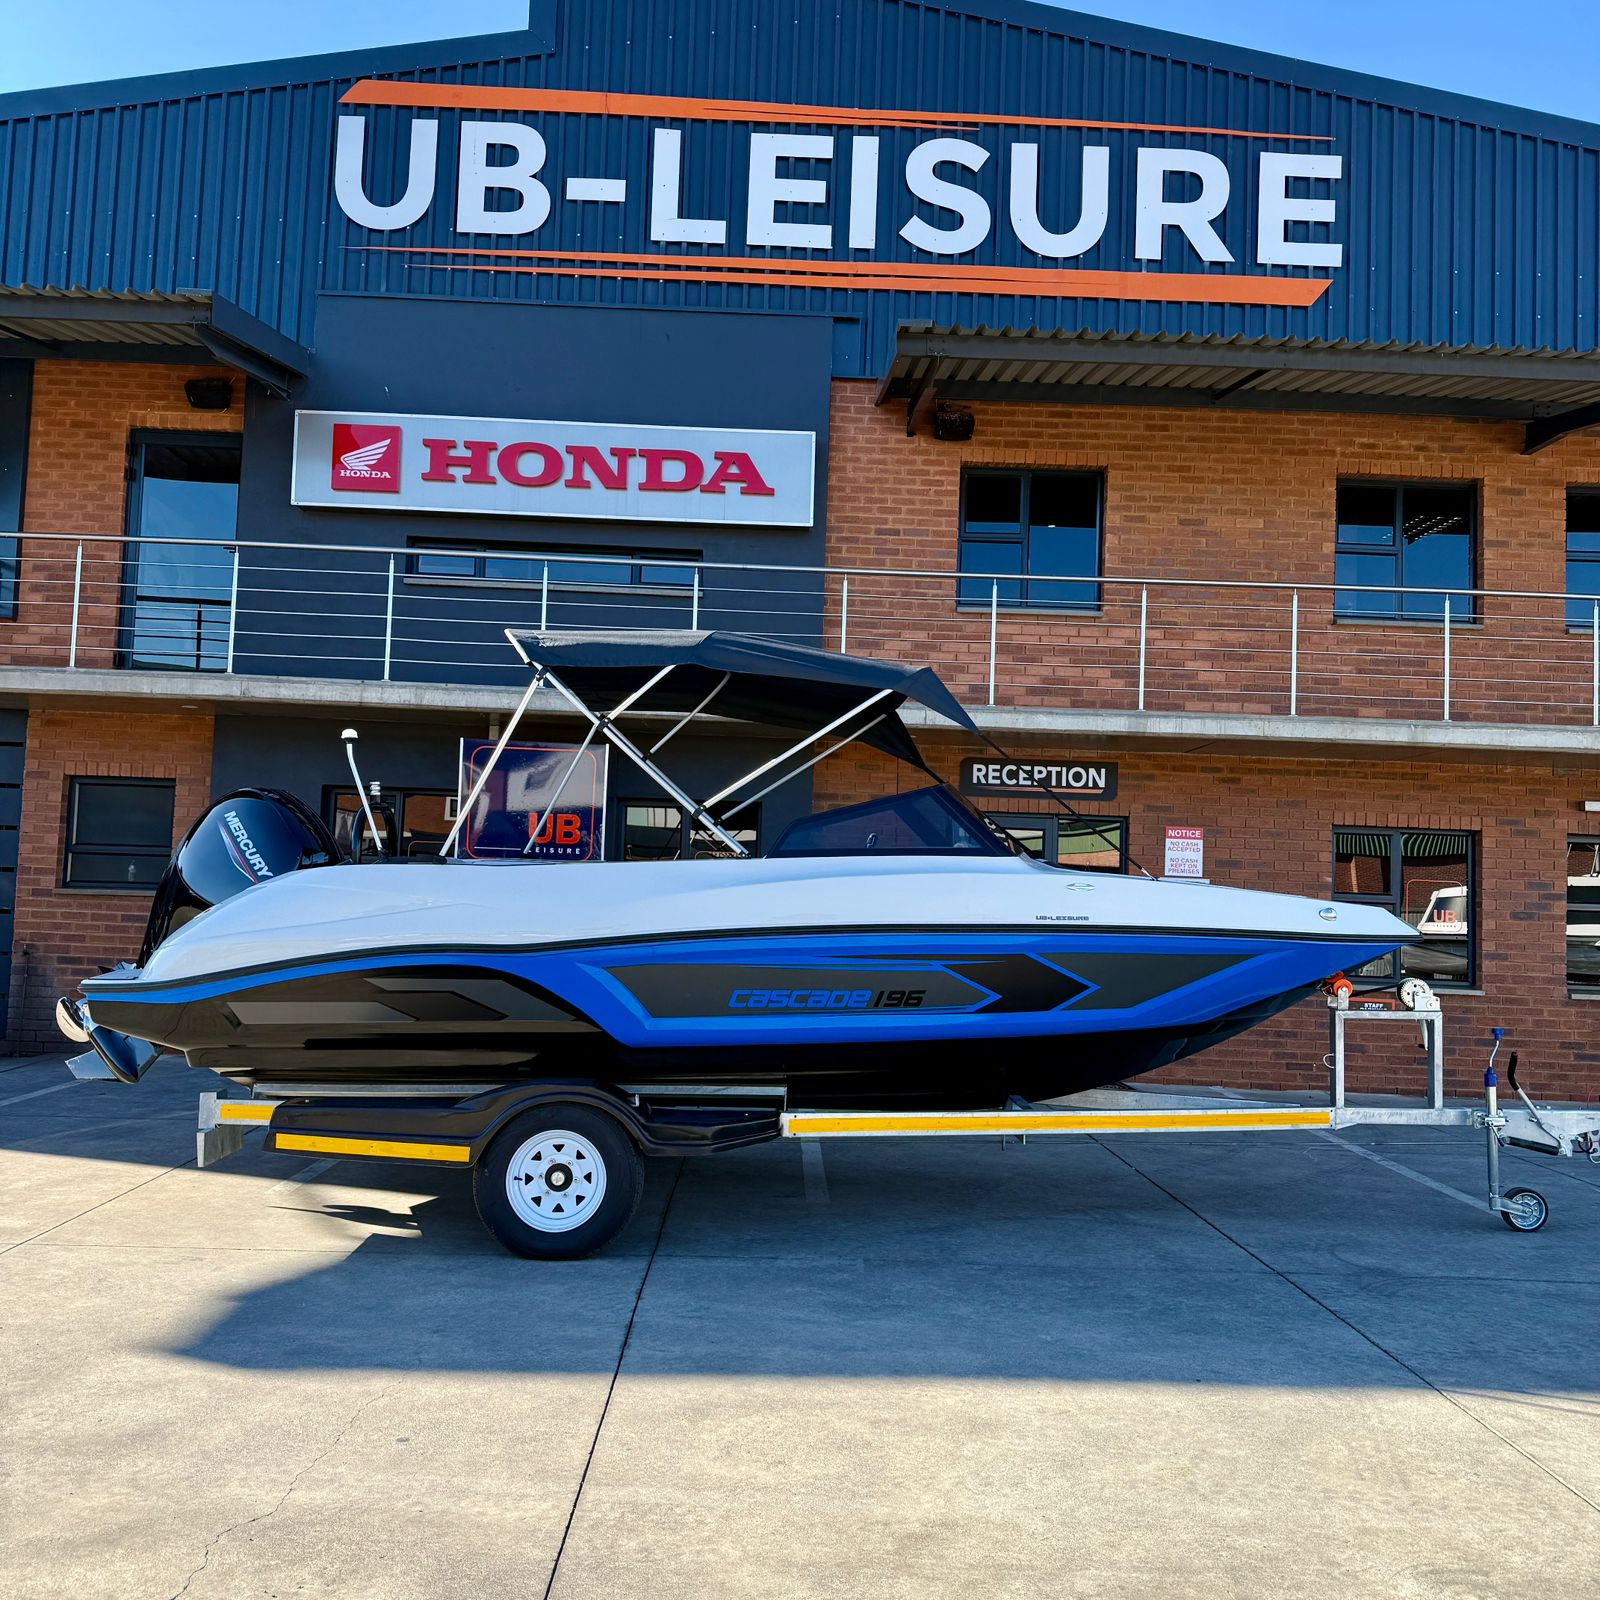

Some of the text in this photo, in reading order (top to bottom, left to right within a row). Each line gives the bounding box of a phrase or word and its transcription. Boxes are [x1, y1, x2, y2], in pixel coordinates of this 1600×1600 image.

[334, 115, 1343, 268] UB-LEISURE
[340, 469, 392, 479] HONDA
[421, 438, 776, 497] HONDA
[972, 763, 1106, 788] RECEPTION
[528, 812, 581, 845] UB
[1168, 829, 1201, 838] NOTICE
[224, 810, 274, 878] MERCURY
[529, 846, 581, 855] EISURE
[1433, 909, 1457, 924] UB
[873, 989, 927, 1008] 196
